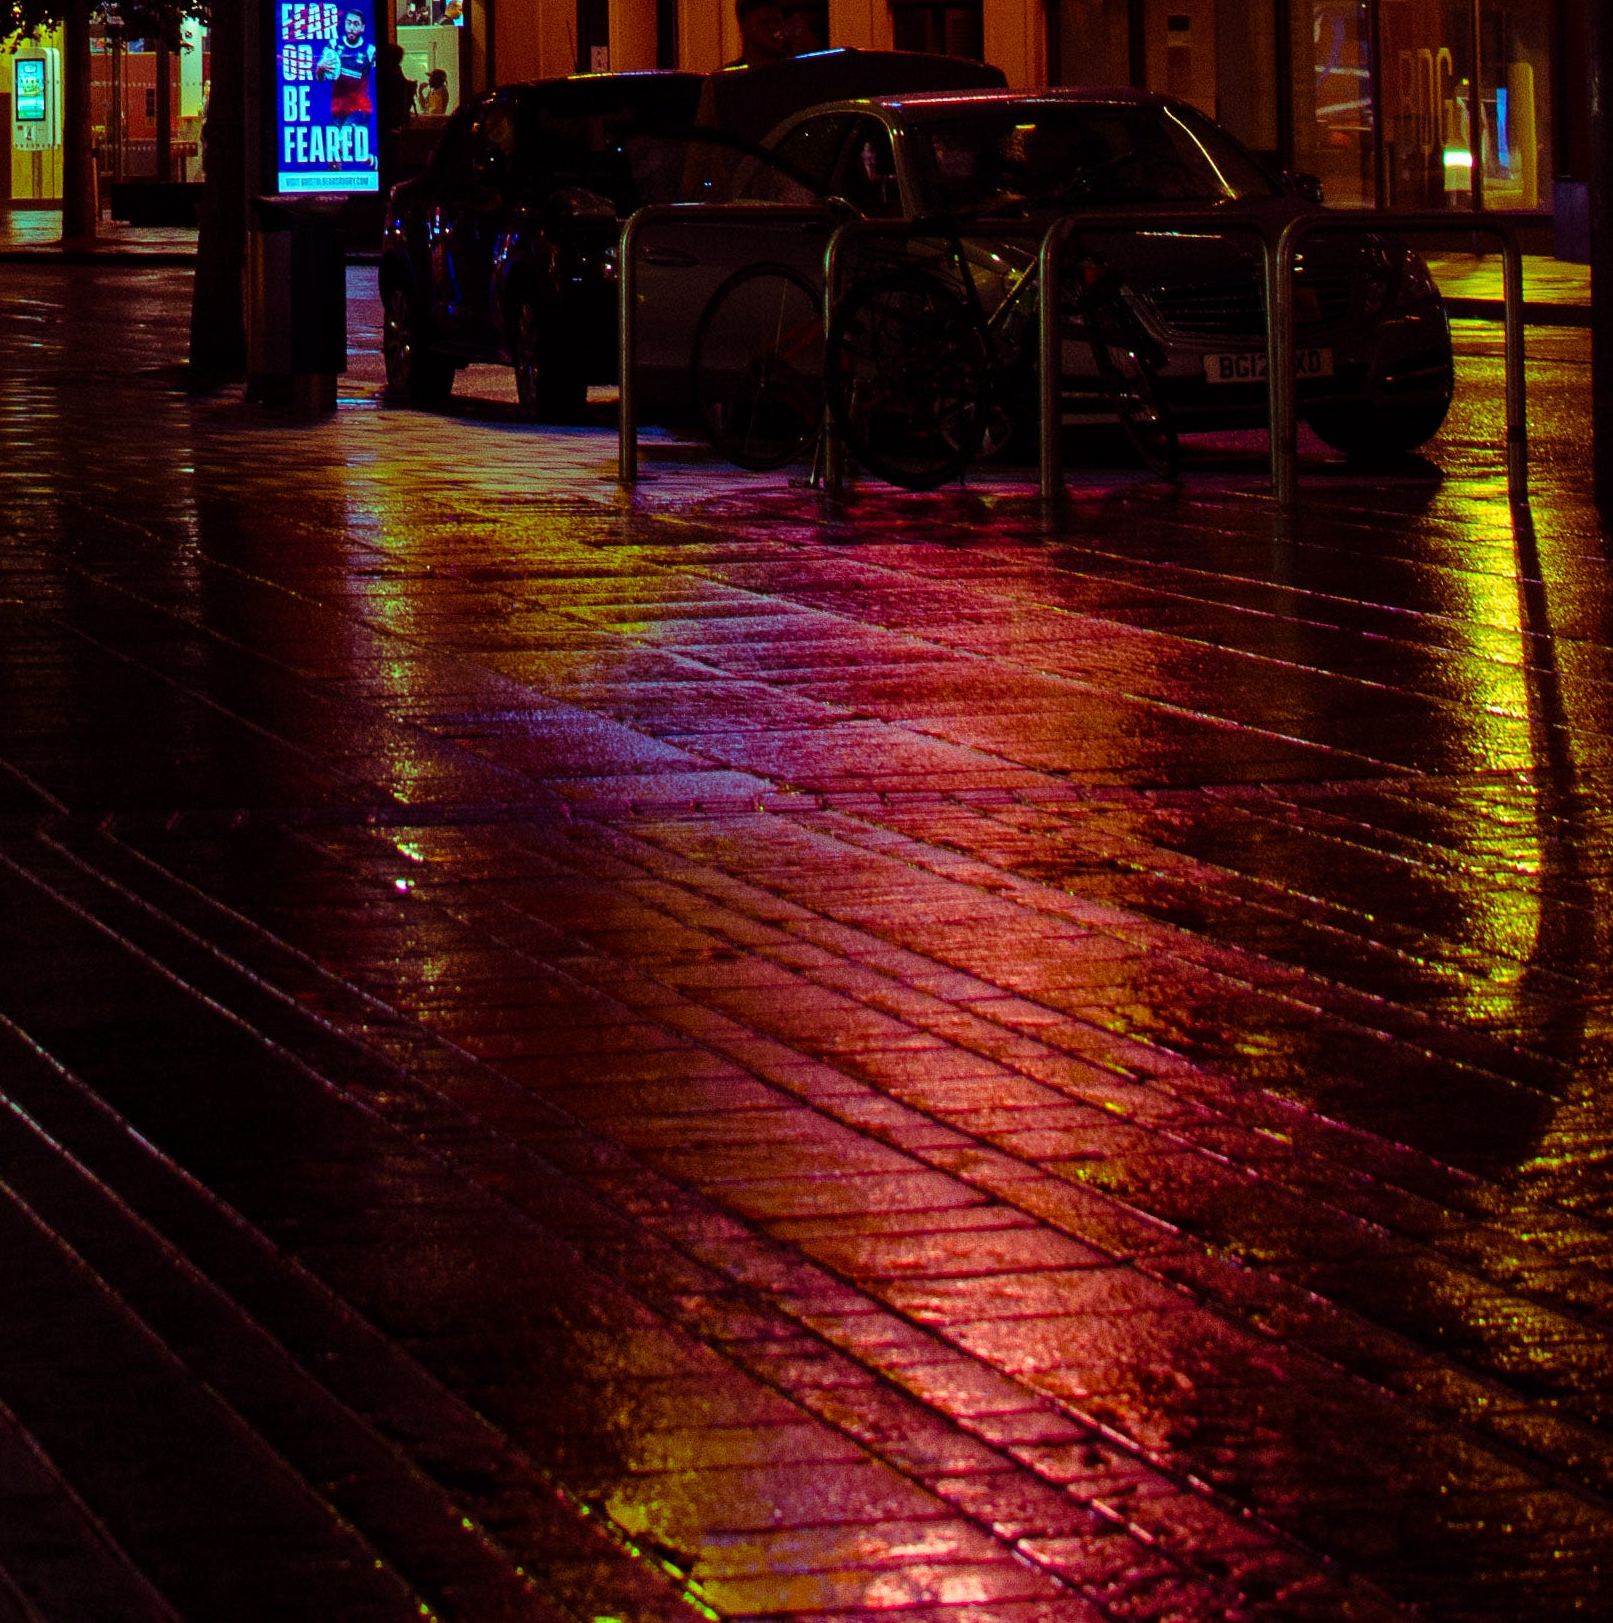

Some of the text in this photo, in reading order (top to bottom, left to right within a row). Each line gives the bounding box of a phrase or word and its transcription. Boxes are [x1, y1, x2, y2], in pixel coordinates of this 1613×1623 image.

[281, 2, 339, 40] FEAR
[282, 43, 314, 81] OR
[283, 85, 310, 122] BE
